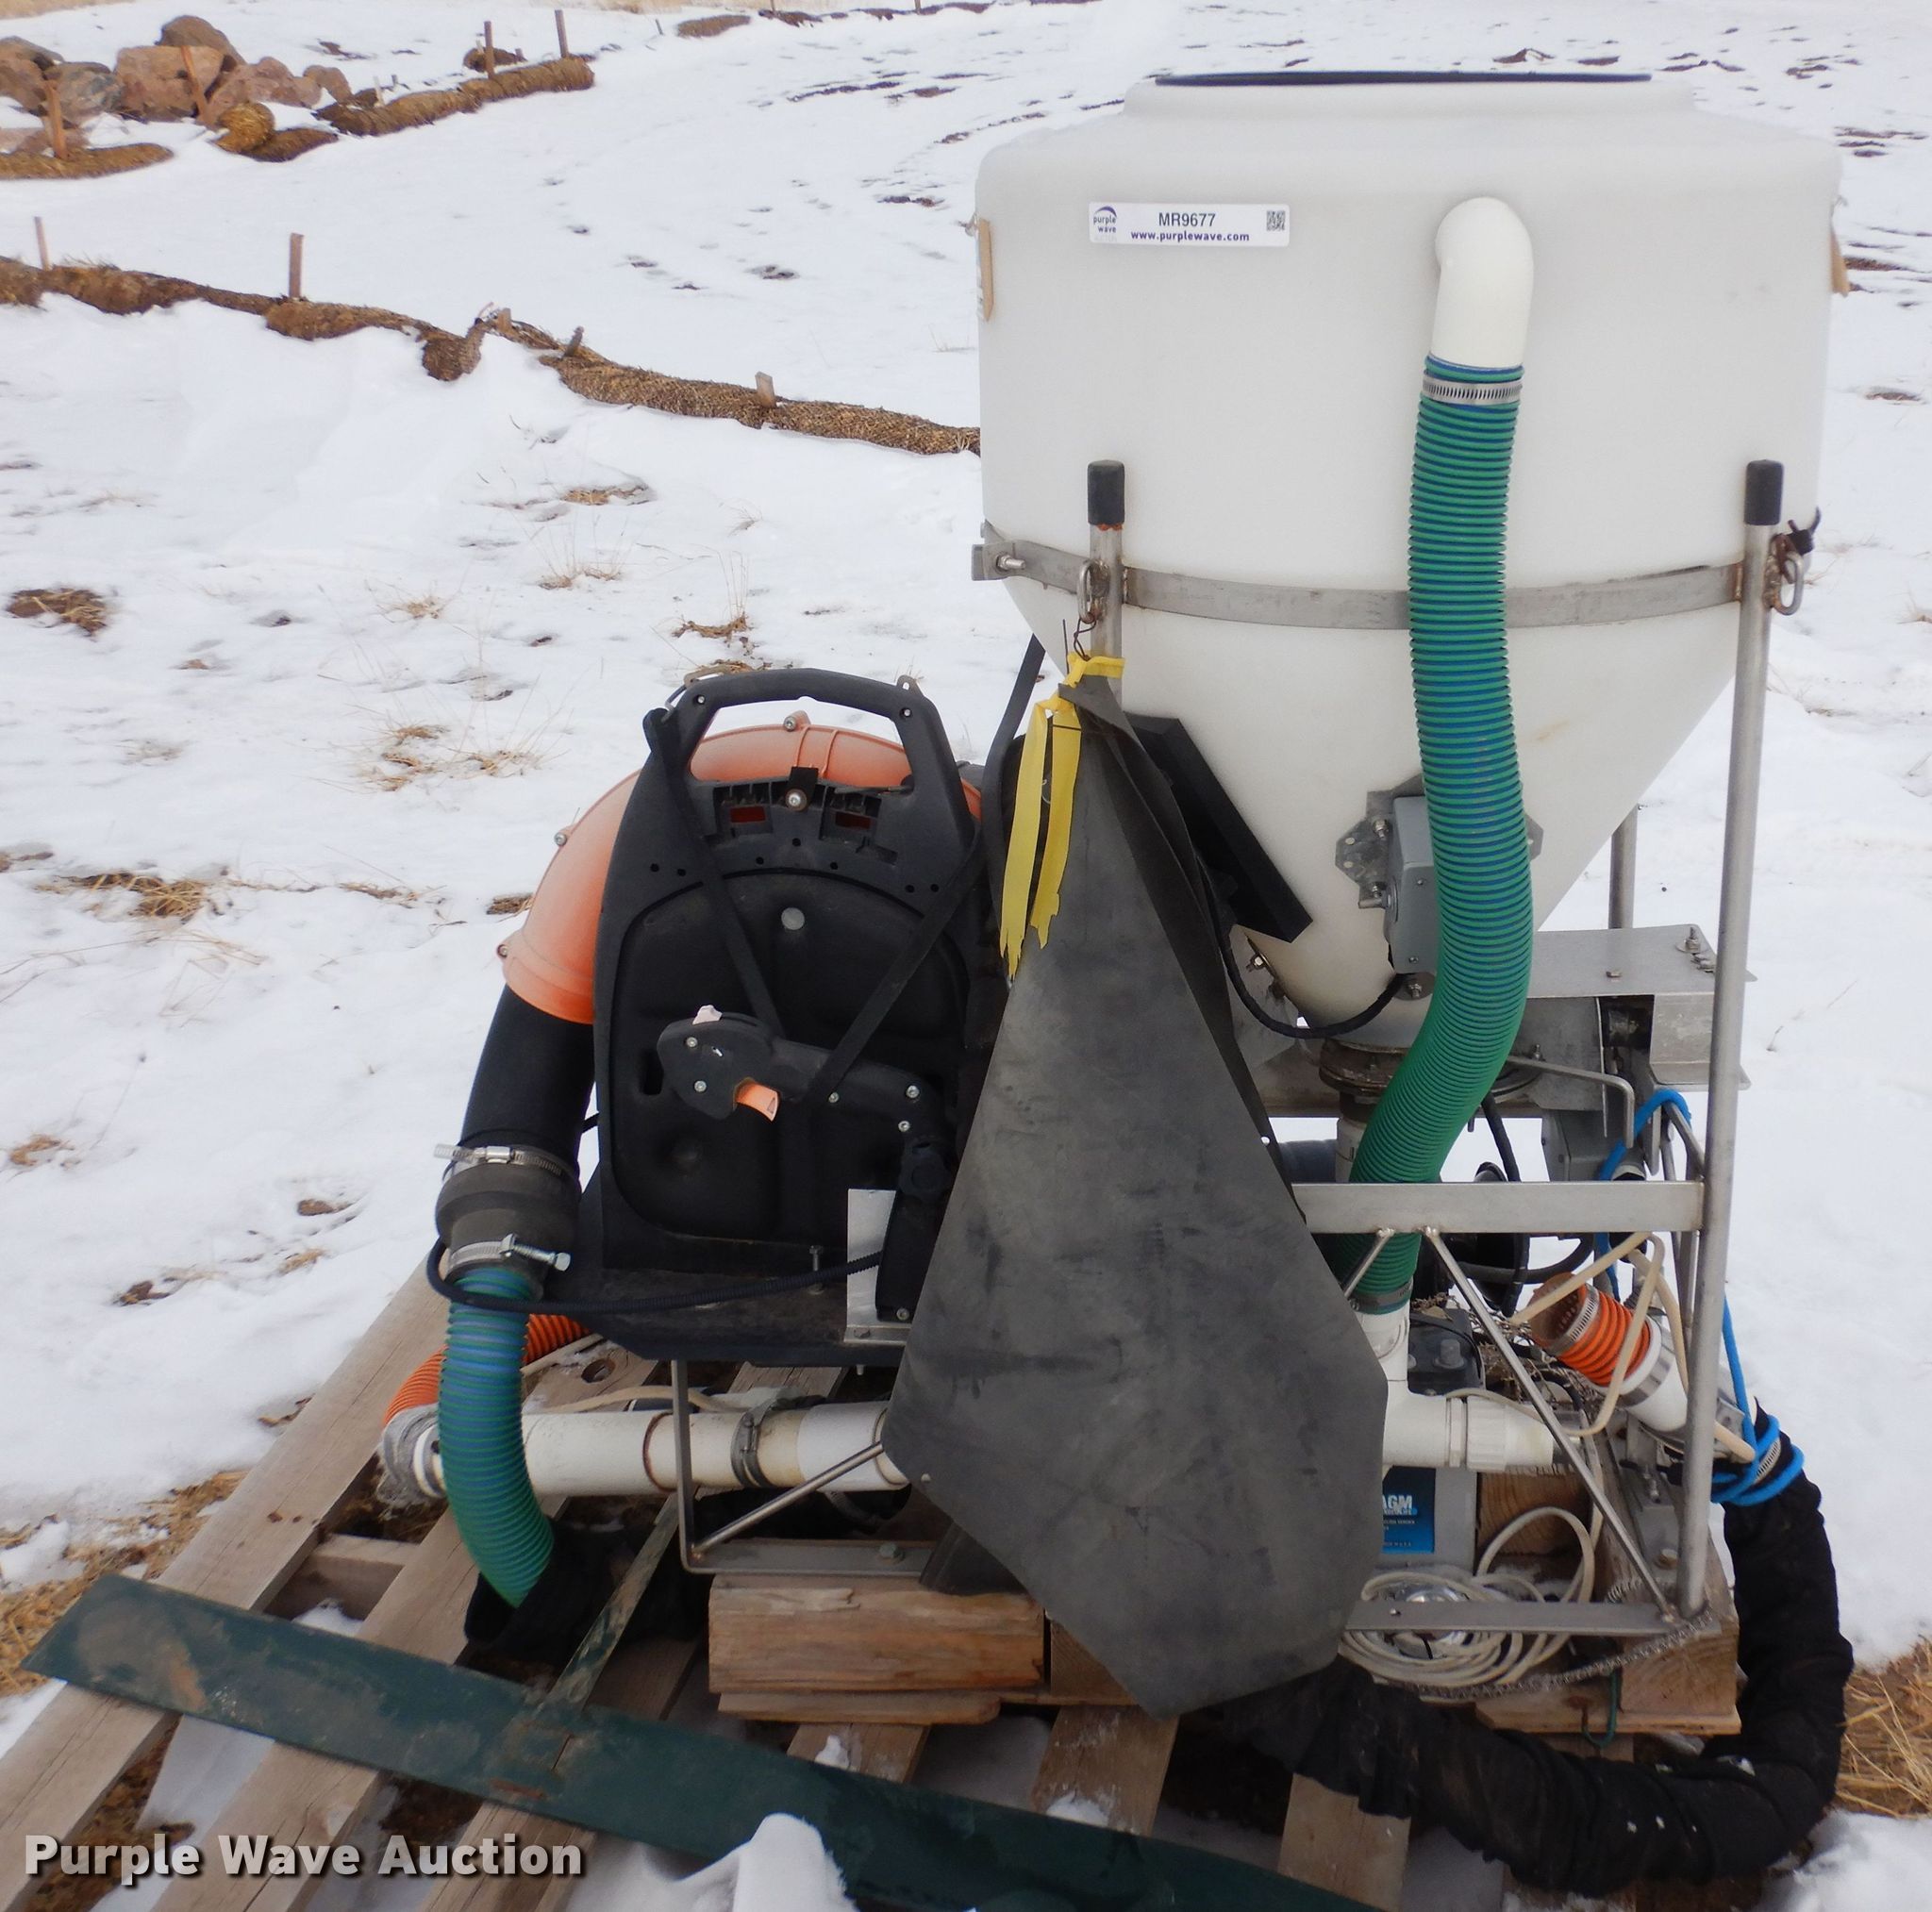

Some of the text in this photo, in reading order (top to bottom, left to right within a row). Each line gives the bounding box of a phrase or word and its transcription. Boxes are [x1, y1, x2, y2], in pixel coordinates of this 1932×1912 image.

[1093, 214, 1116, 225] purple
[1158, 212, 1216, 227] MR9677
[1131, 230, 1250, 242] www.purplewave.com
